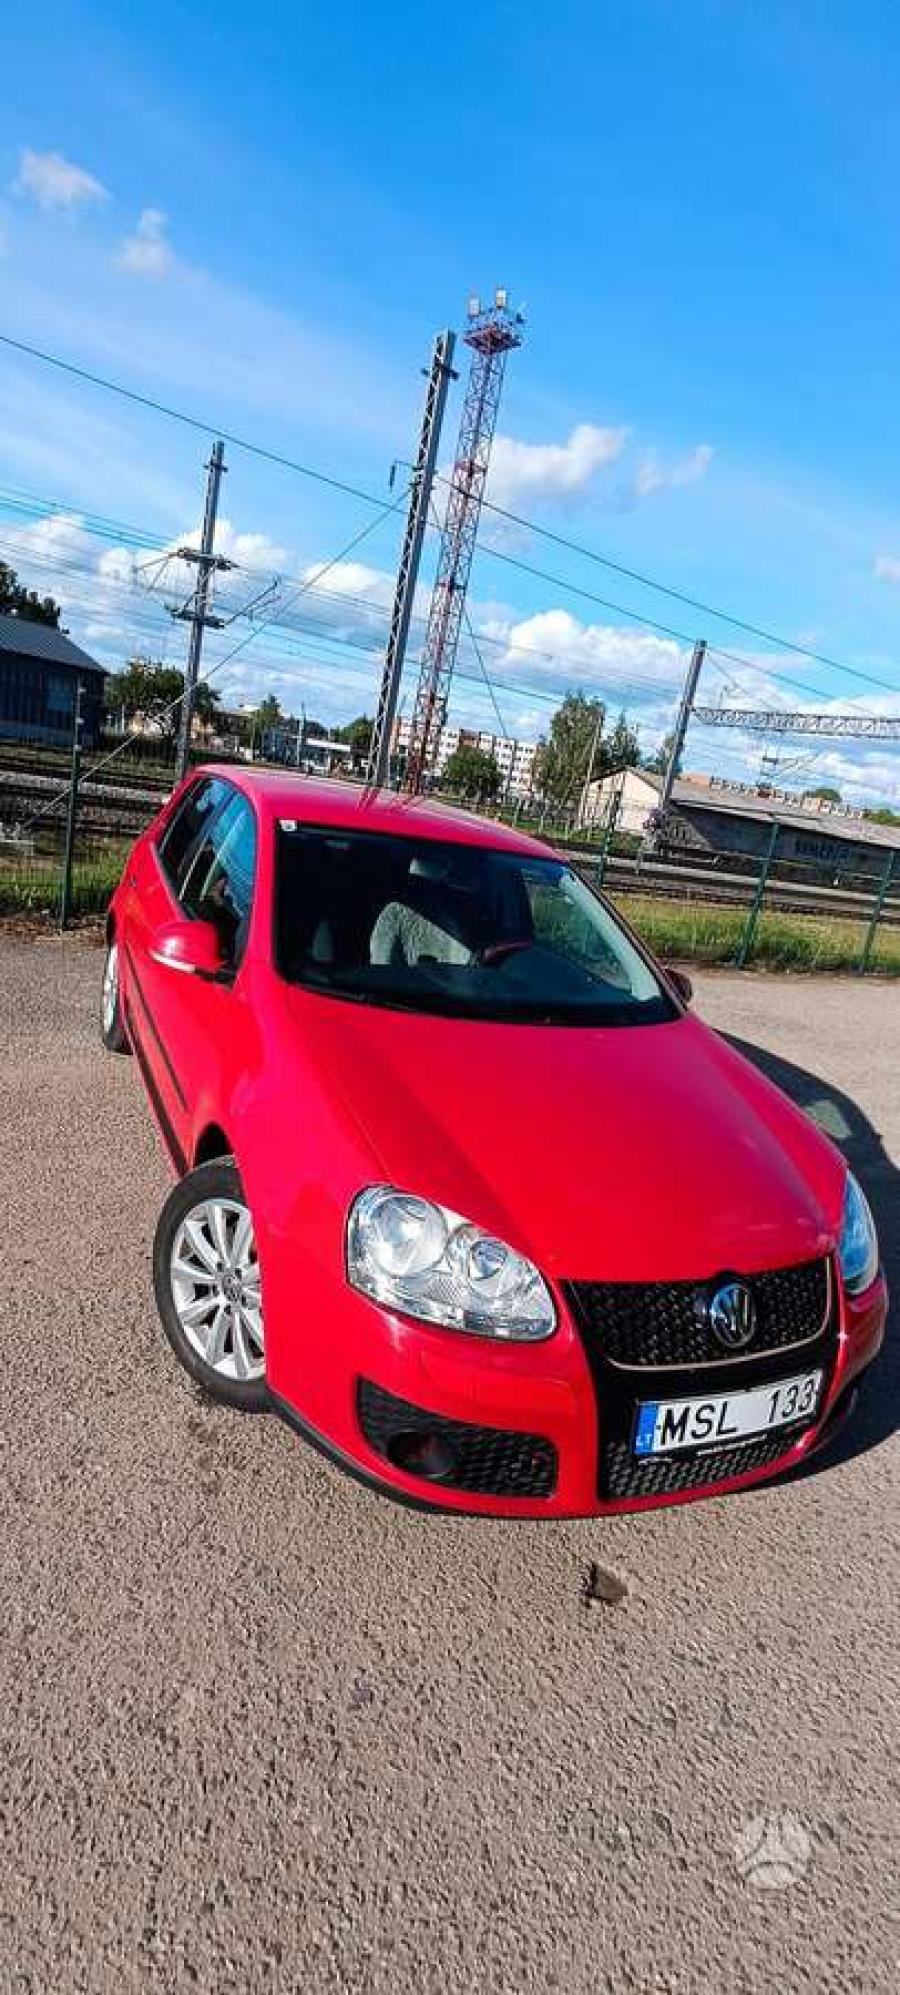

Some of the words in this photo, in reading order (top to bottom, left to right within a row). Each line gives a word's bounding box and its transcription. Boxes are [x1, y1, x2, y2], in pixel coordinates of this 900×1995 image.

[661, 1401, 737, 1445] MSL
[769, 1379, 815, 1423] 133
[636, 1434, 652, 1448] LT
